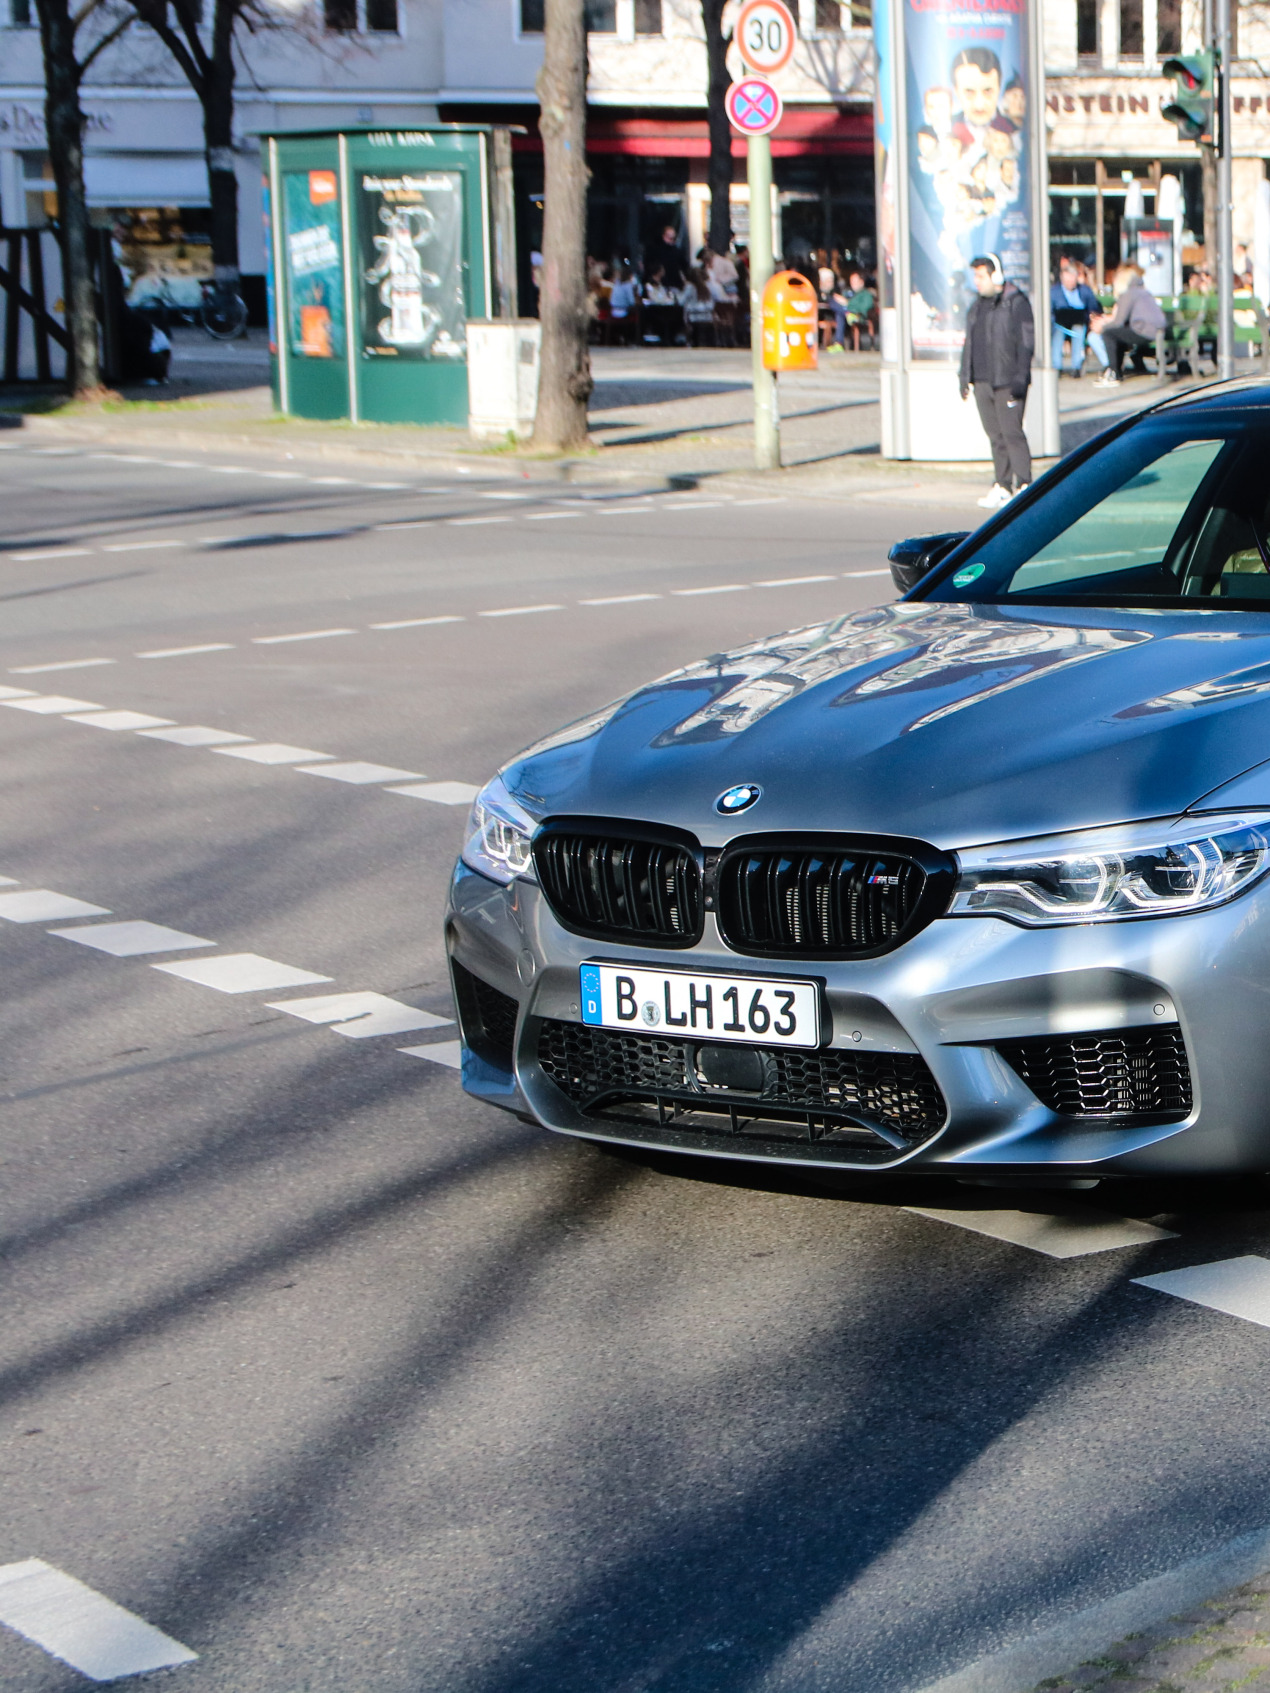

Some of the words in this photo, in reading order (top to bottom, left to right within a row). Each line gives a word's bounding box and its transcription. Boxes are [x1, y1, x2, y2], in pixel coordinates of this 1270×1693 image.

[749, 18, 782, 52] 30
[588, 1000, 597, 1014] D
[615, 975, 638, 1021] B
